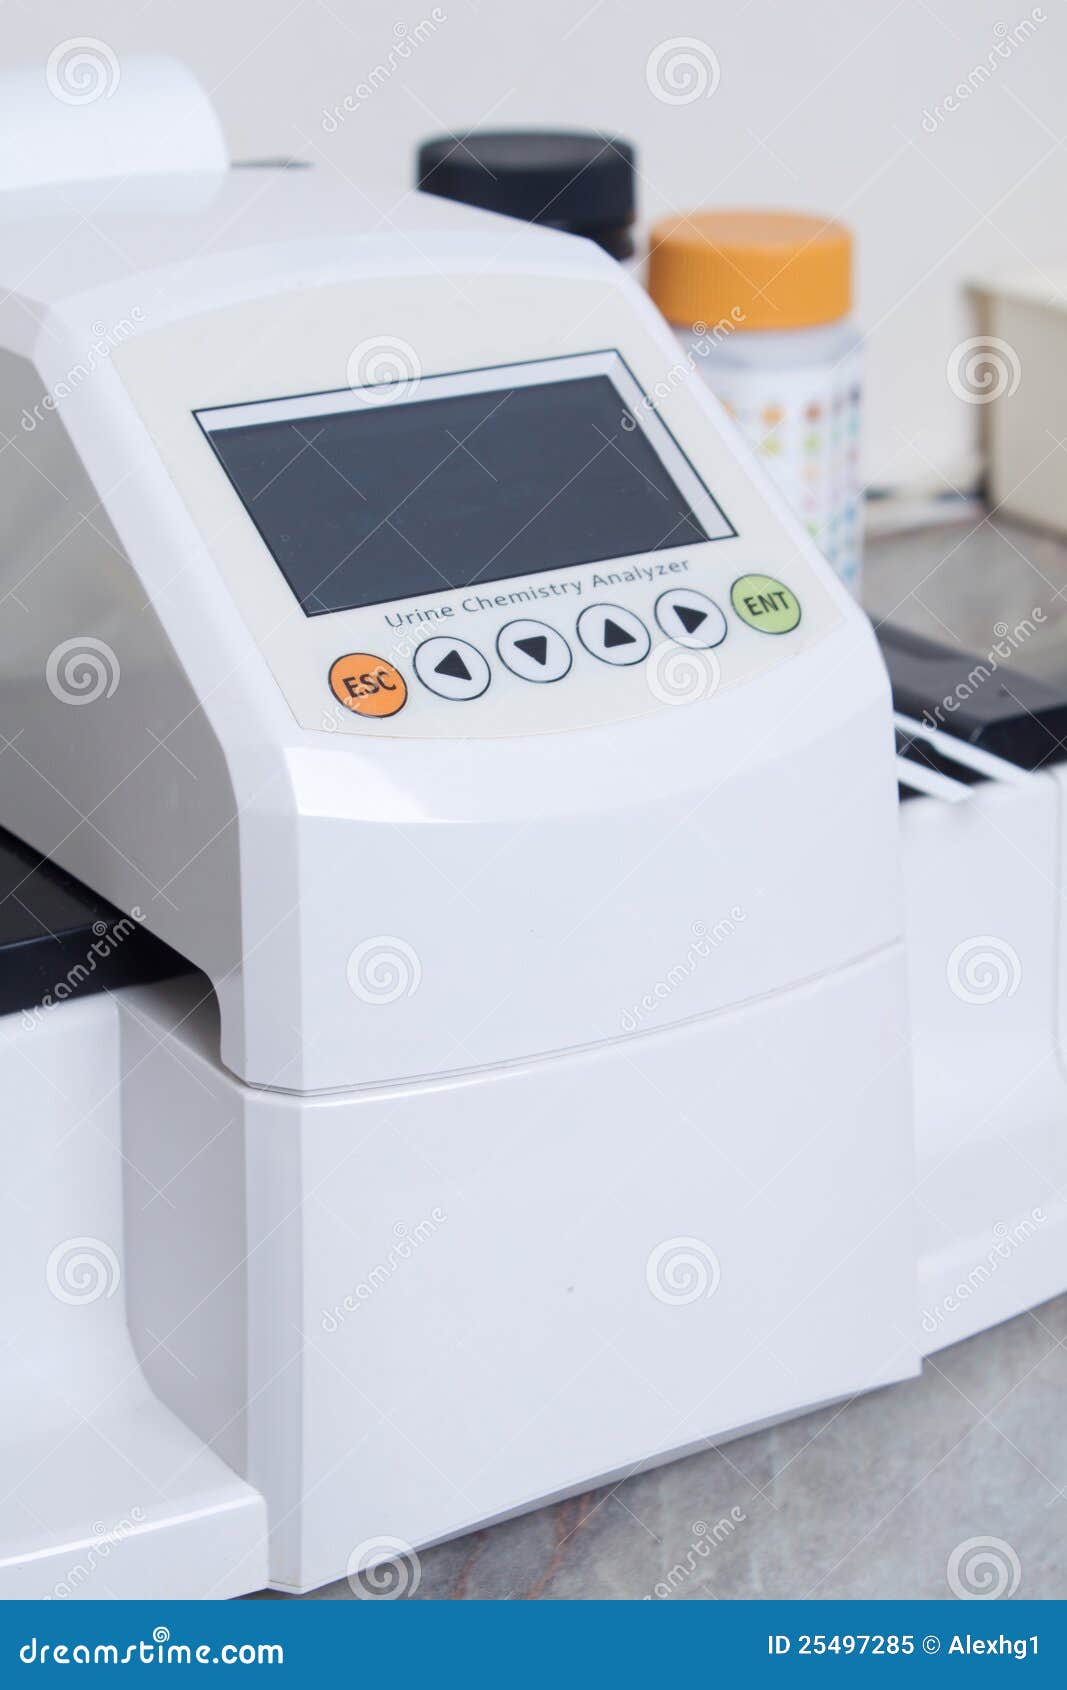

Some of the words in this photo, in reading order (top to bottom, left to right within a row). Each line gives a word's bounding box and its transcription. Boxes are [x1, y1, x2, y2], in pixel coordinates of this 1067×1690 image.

[384, 606, 455, 629] Urine
[462, 579, 583, 613] Chemistry
[592, 559, 690, 588] Analyzer
[743, 591, 790, 617] ENT
[342, 670, 397, 699] ESC
